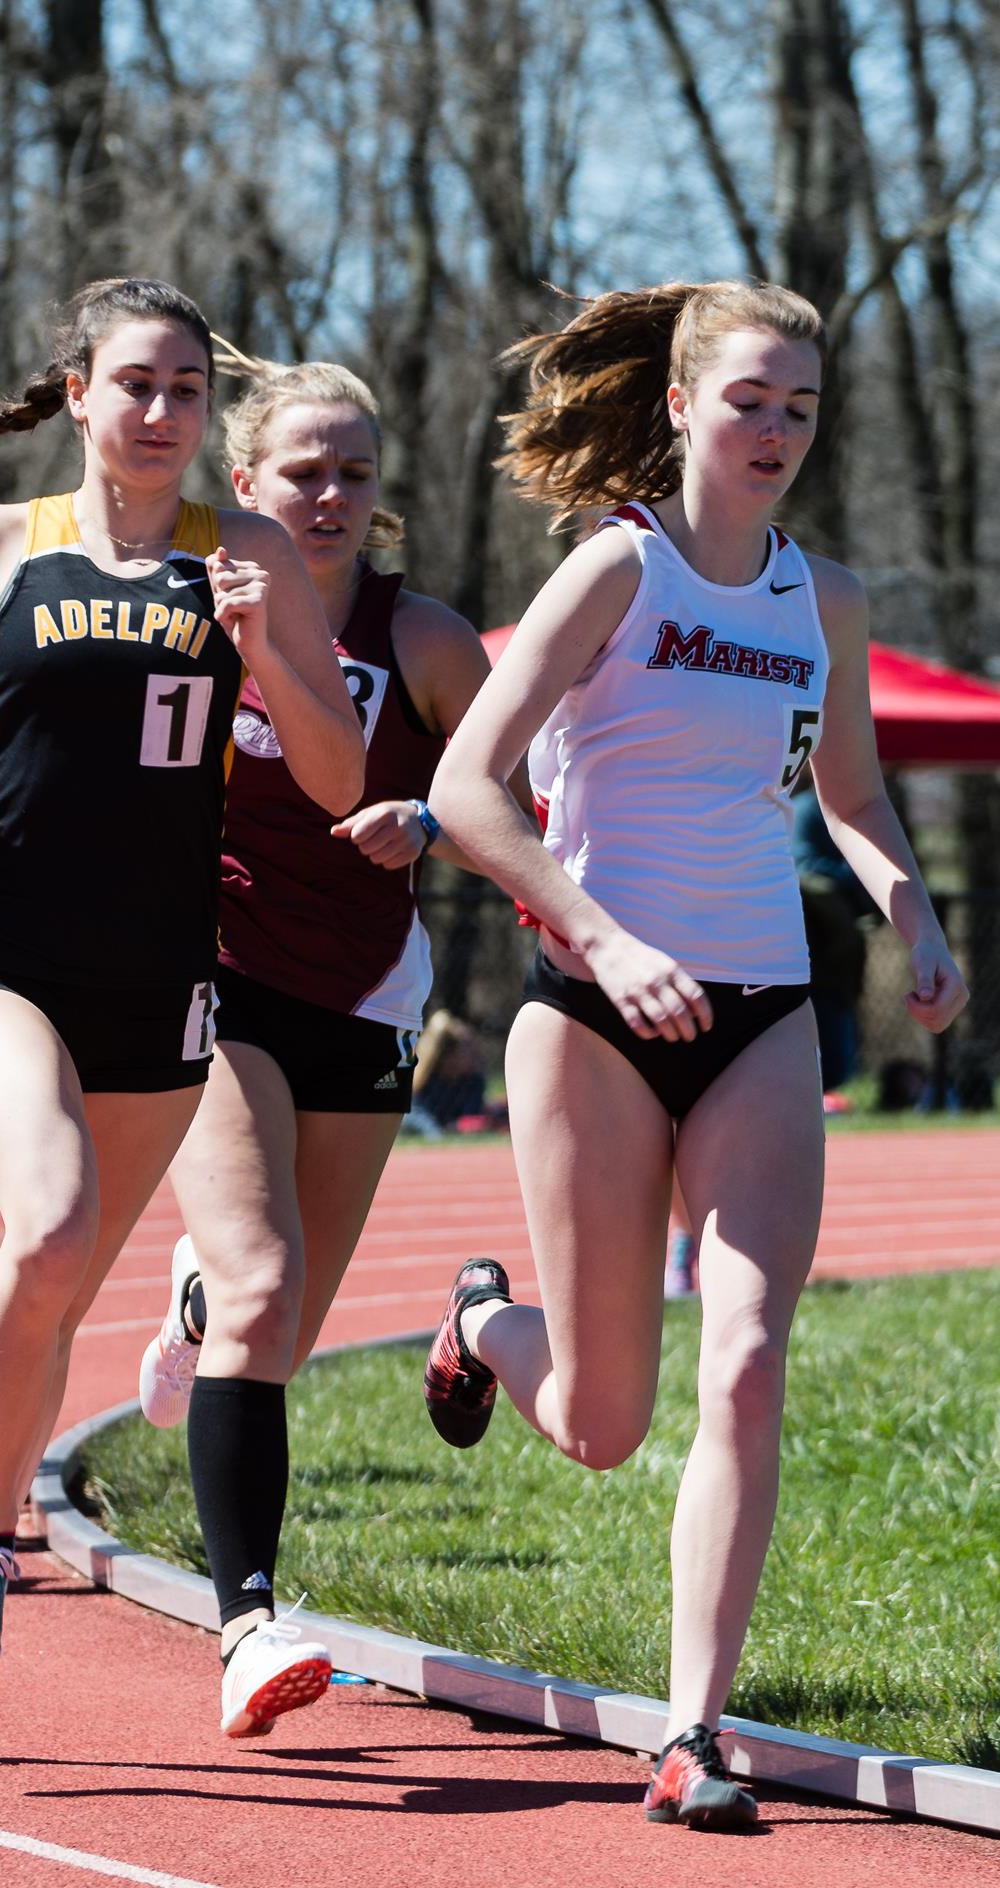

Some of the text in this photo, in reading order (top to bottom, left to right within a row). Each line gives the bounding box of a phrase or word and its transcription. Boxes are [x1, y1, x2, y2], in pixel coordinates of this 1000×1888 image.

[33, 599, 211, 659] ADELPHI
[157, 683, 191, 761] 1
[782, 710, 819, 787] 5
[198, 981, 212, 1053] 1
